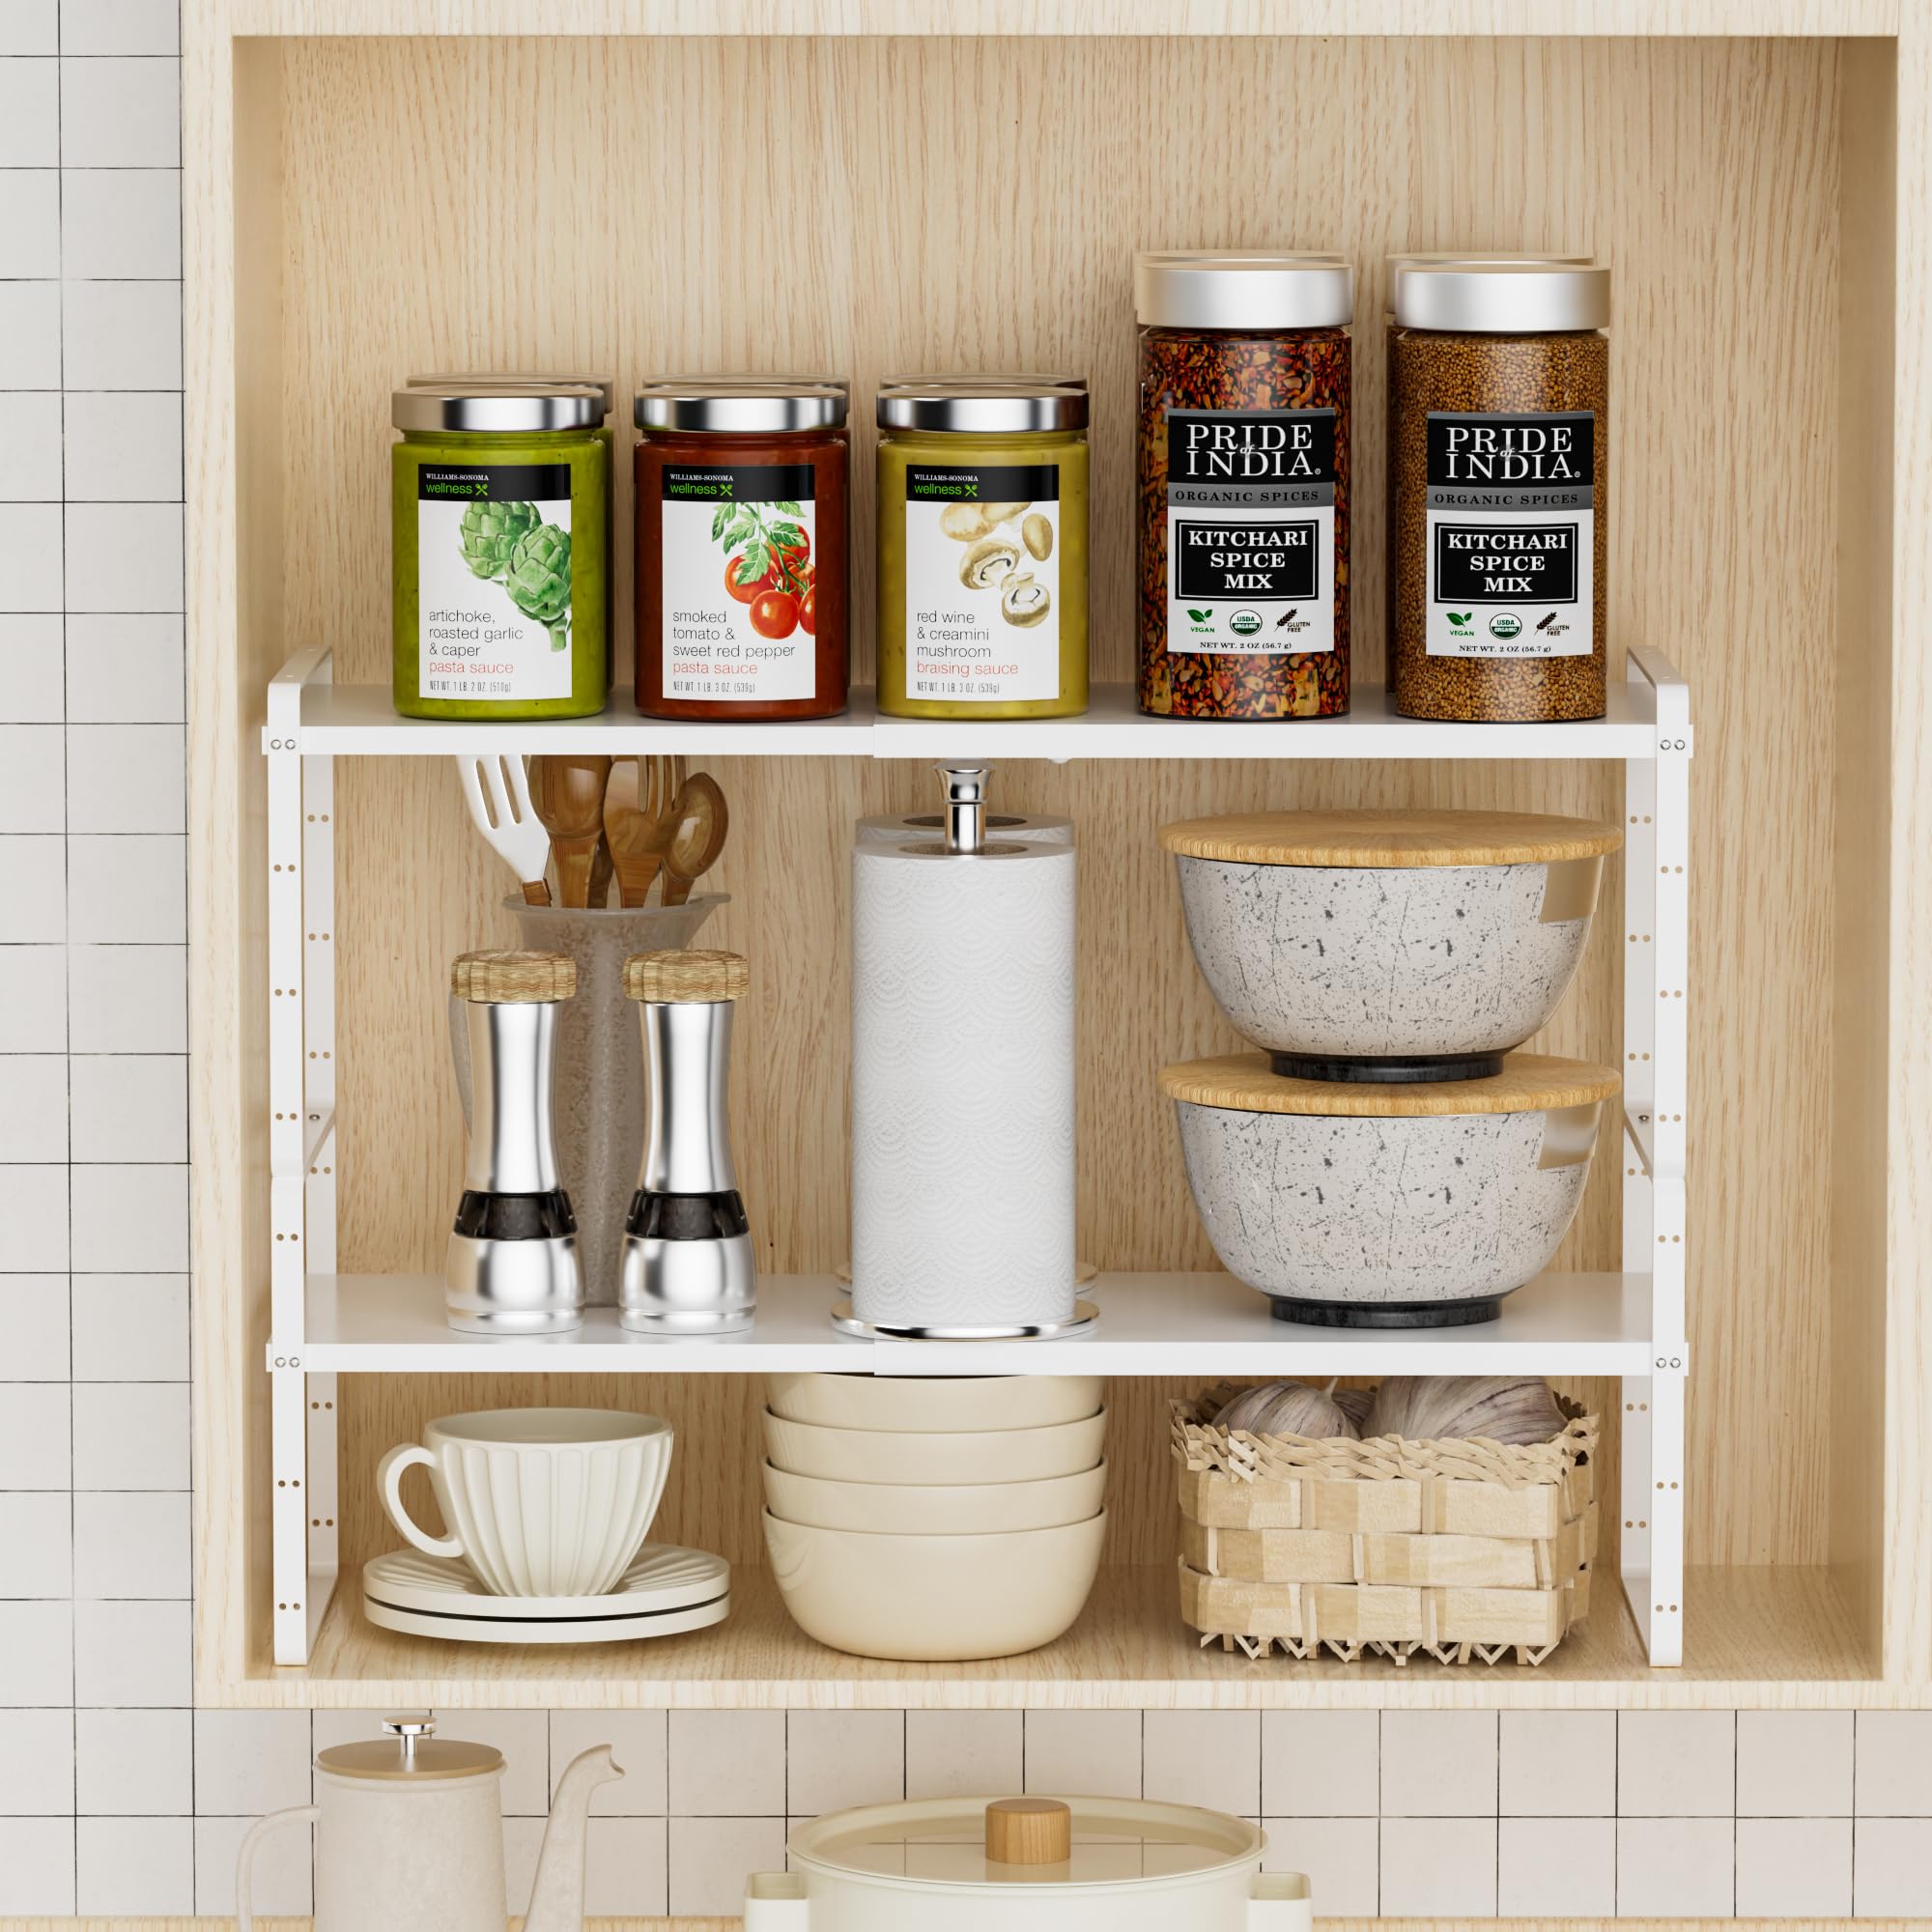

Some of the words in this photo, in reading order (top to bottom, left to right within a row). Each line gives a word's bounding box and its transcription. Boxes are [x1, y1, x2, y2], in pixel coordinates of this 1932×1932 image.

[1186, 424, 1313, 450] PRIDE
[1445, 427, 1573, 453] PRIDE
[1239, 444, 1255, 454] of
[1499, 447, 1515, 458] of
[1186, 450, 1314, 476] INDIA
[1445, 453, 1573, 479] INDIA
[426, 472, 489, 481] WILLIAMS-SONOMA
[670, 473, 733, 482] WILLIAMS-SONOMA
[426, 483, 472, 494] wellness
[670, 484, 717, 495] wellness
[915, 484, 962, 495] wellness
[1176, 491, 1253, 501] ORGANIC
[1260, 491, 1319, 501] SPICES
[1435, 494, 1513, 504] ORGANIC
[1520, 494, 1577, 504] SPICES
[1188, 530, 1308, 547] KITCHARI
[1448, 533, 1567, 550] KITCHARI
[1210, 553, 1286, 568] SPICE
[1470, 555, 1546, 571] SPICE
[1224, 574, 1273, 588] MIX
[1484, 577, 1533, 592] MIX
[429, 611, 496, 623] artichoke,
[673, 611, 726, 623] smoked
[917, 611, 937, 623] red
[942, 611, 975, 623] wine
[429, 627, 479, 639] roasted
[484, 628, 523, 642] garlic
[673, 627, 720, 639] tomato
[725, 628, 735, 639] &
[917, 627, 925, 639] &
[929, 628, 989, 640] creamini
[430, 642, 438, 656] &
[442, 645, 480, 658] caper
[673, 645, 711, 657] sweet
[717, 645, 740, 657] red
[746, 646, 795, 660] pepper
[917, 645, 991, 657] mushroom
[429, 662, 465, 674] pasta
[469, 664, 514, 673] sauce
[673, 662, 709, 674] pasta
[714, 665, 757, 674] sauce
[917, 662, 970, 677] braising
[975, 665, 1018, 674] sauce
[430, 681, 440, 691] NET
[471, 682, 475, 692] 2
[673, 681, 683, 691] NET
[715, 682, 719, 692] 3
[734, 683, 755, 694] (539g)
[917, 682, 926, 692] NET
[959, 683, 963, 693] 3
[979, 683, 999, 694] (539g)
